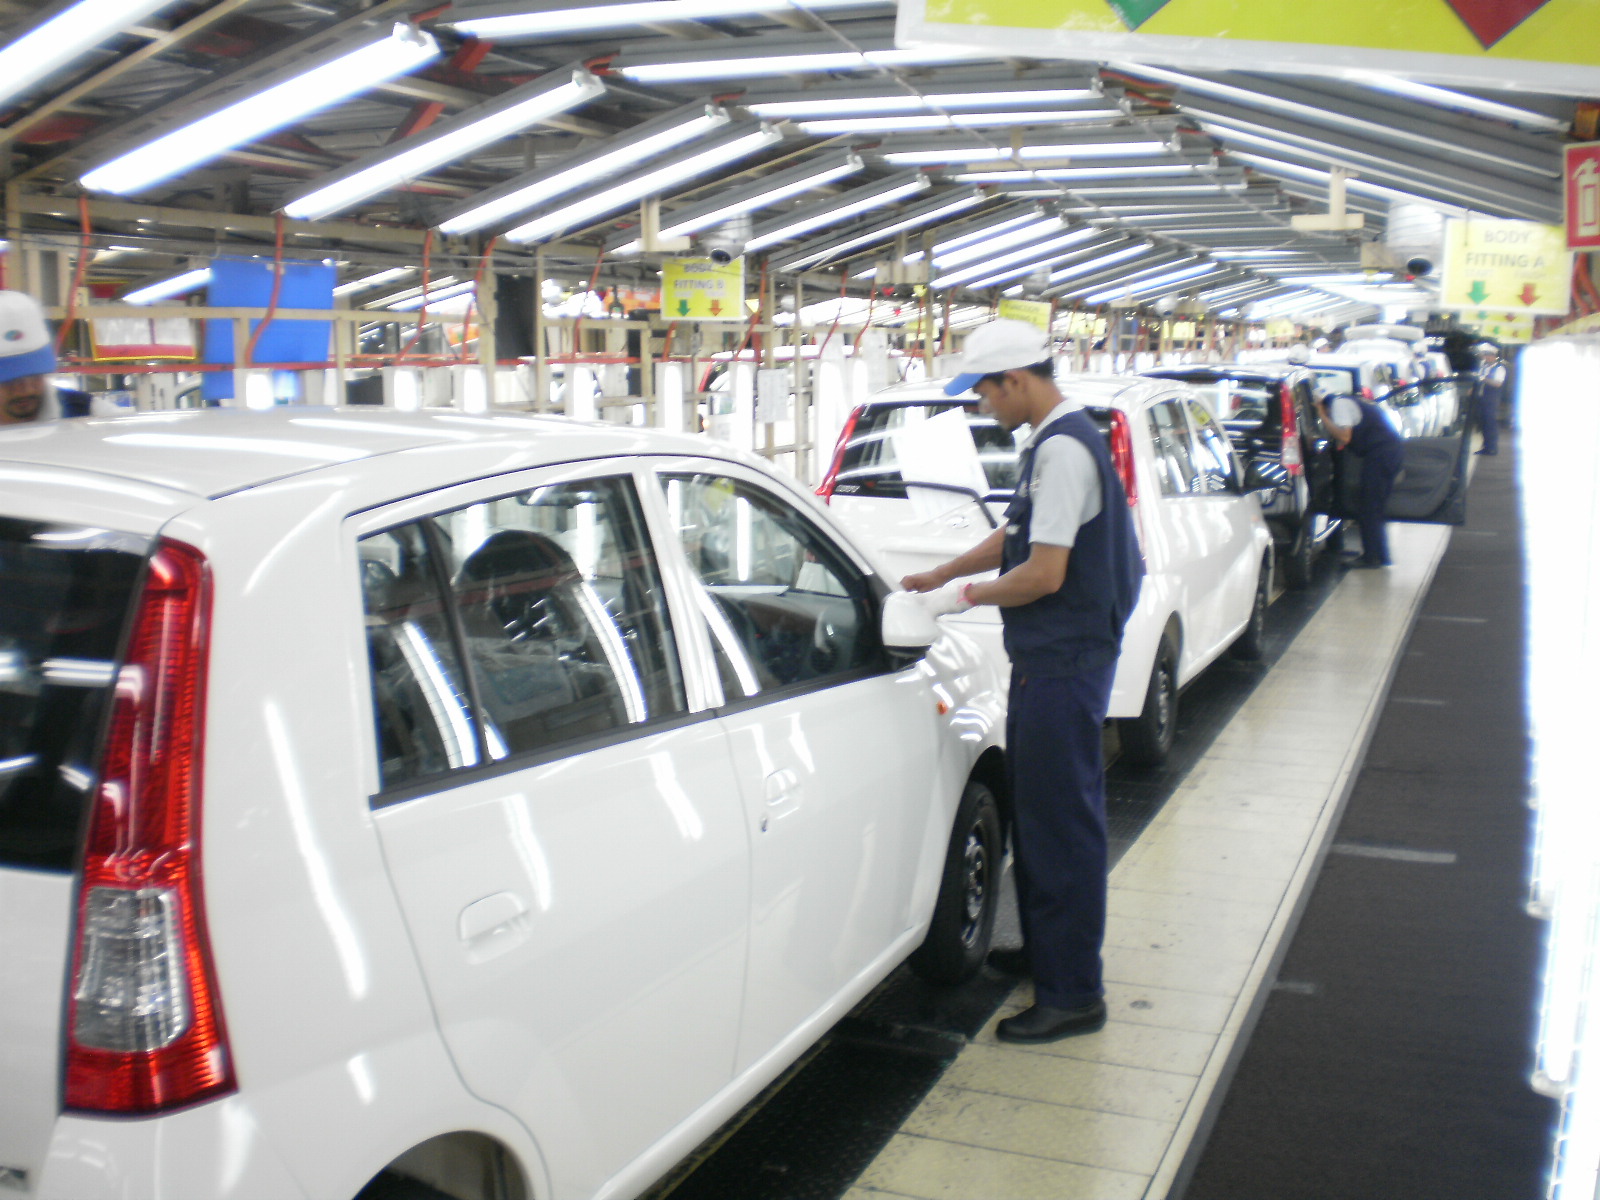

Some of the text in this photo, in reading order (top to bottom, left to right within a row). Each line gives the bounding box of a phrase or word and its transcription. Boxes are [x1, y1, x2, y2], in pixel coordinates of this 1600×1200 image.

[1484, 230, 1531, 244] BODY
[1465, 252, 1545, 268] FITTING A
